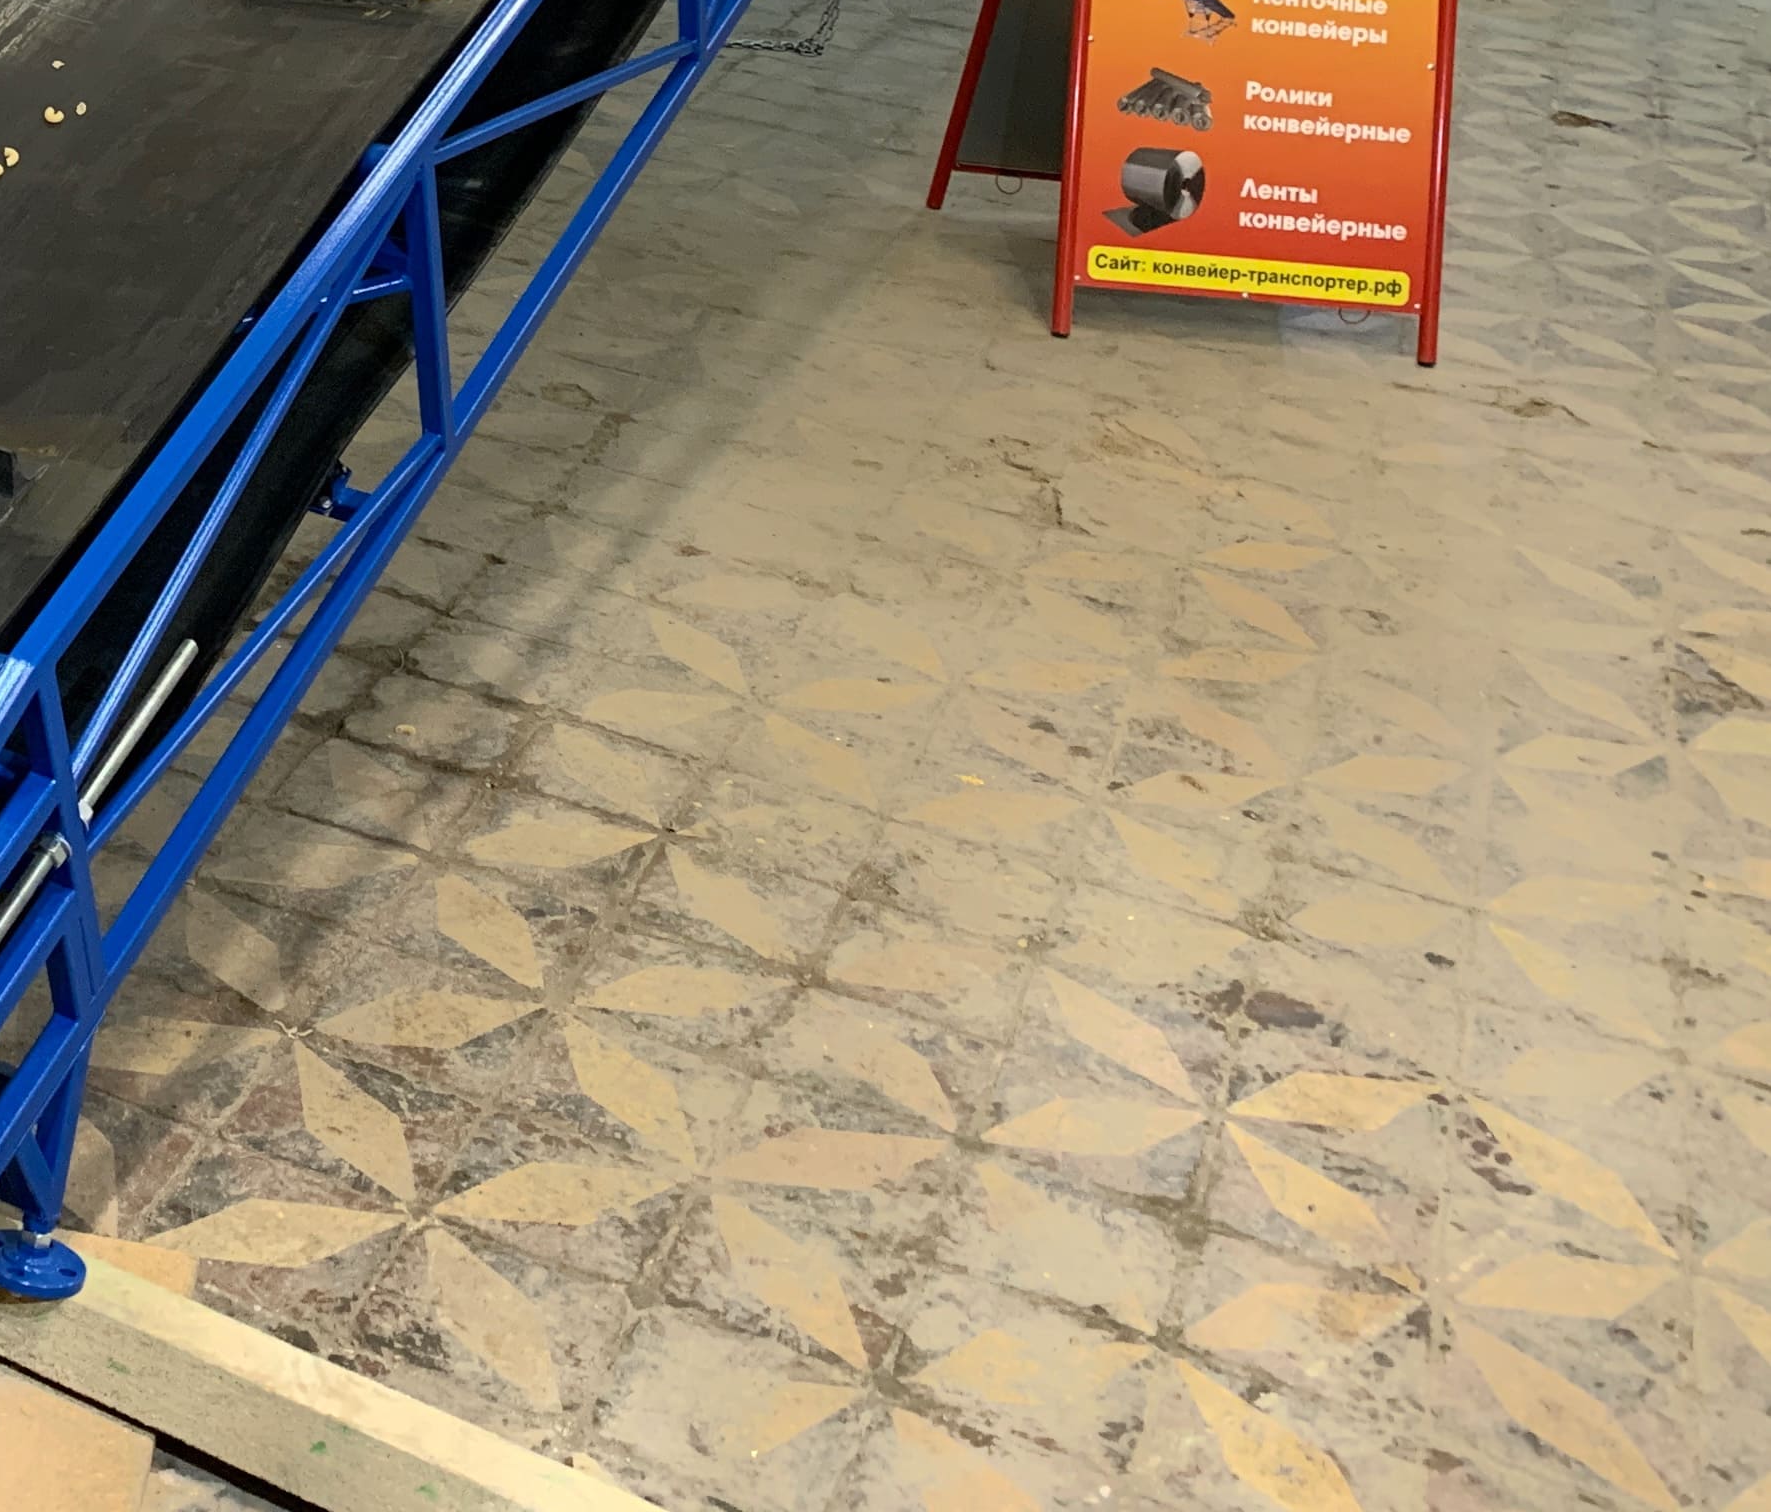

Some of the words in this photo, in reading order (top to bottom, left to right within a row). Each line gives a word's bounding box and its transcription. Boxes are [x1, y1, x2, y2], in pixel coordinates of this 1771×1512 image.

[1251, 17, 1388, 47] конвейеры
[1245, 80, 1333, 108] Ролики
[1243, 115, 1412, 144] конвейерные
[1240, 178, 1318, 204] Ленты
[1239, 212, 1407, 241] конвейерные
[1095, 253, 1146, 273] Сайт:
[1152, 261, 1402, 298] конвейер-транспортер.рф
